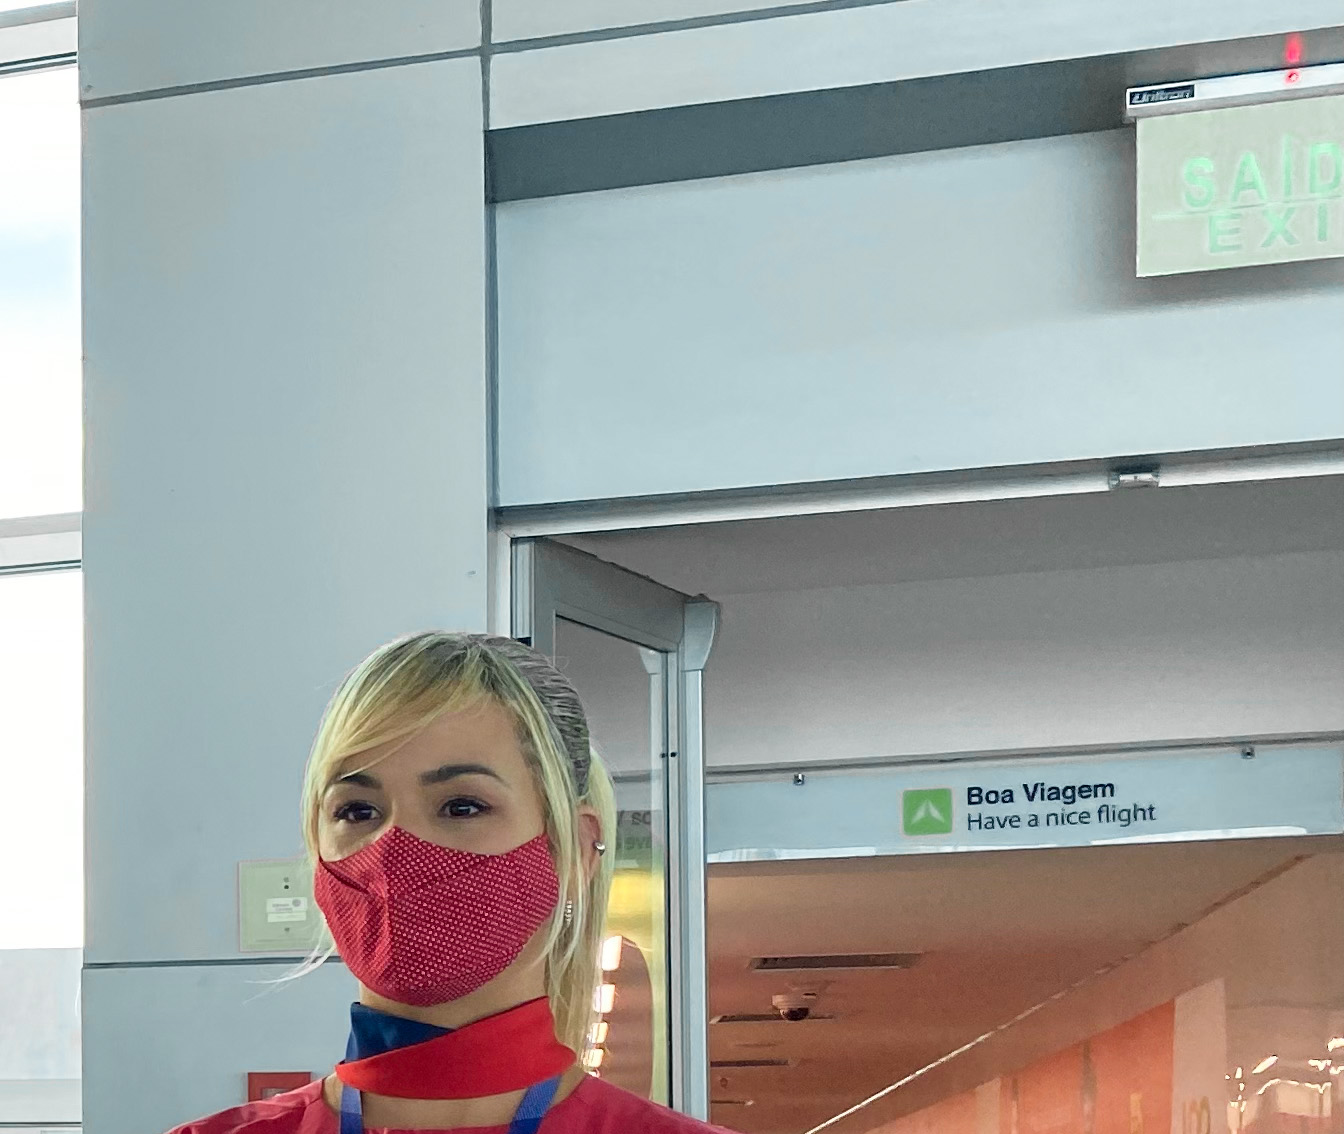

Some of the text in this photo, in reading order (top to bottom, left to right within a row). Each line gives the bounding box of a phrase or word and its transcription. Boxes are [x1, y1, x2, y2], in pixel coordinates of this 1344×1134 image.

[967, 782, 1115, 805] Boa Viagem
[967, 803, 1157, 831] Have a nice flight
